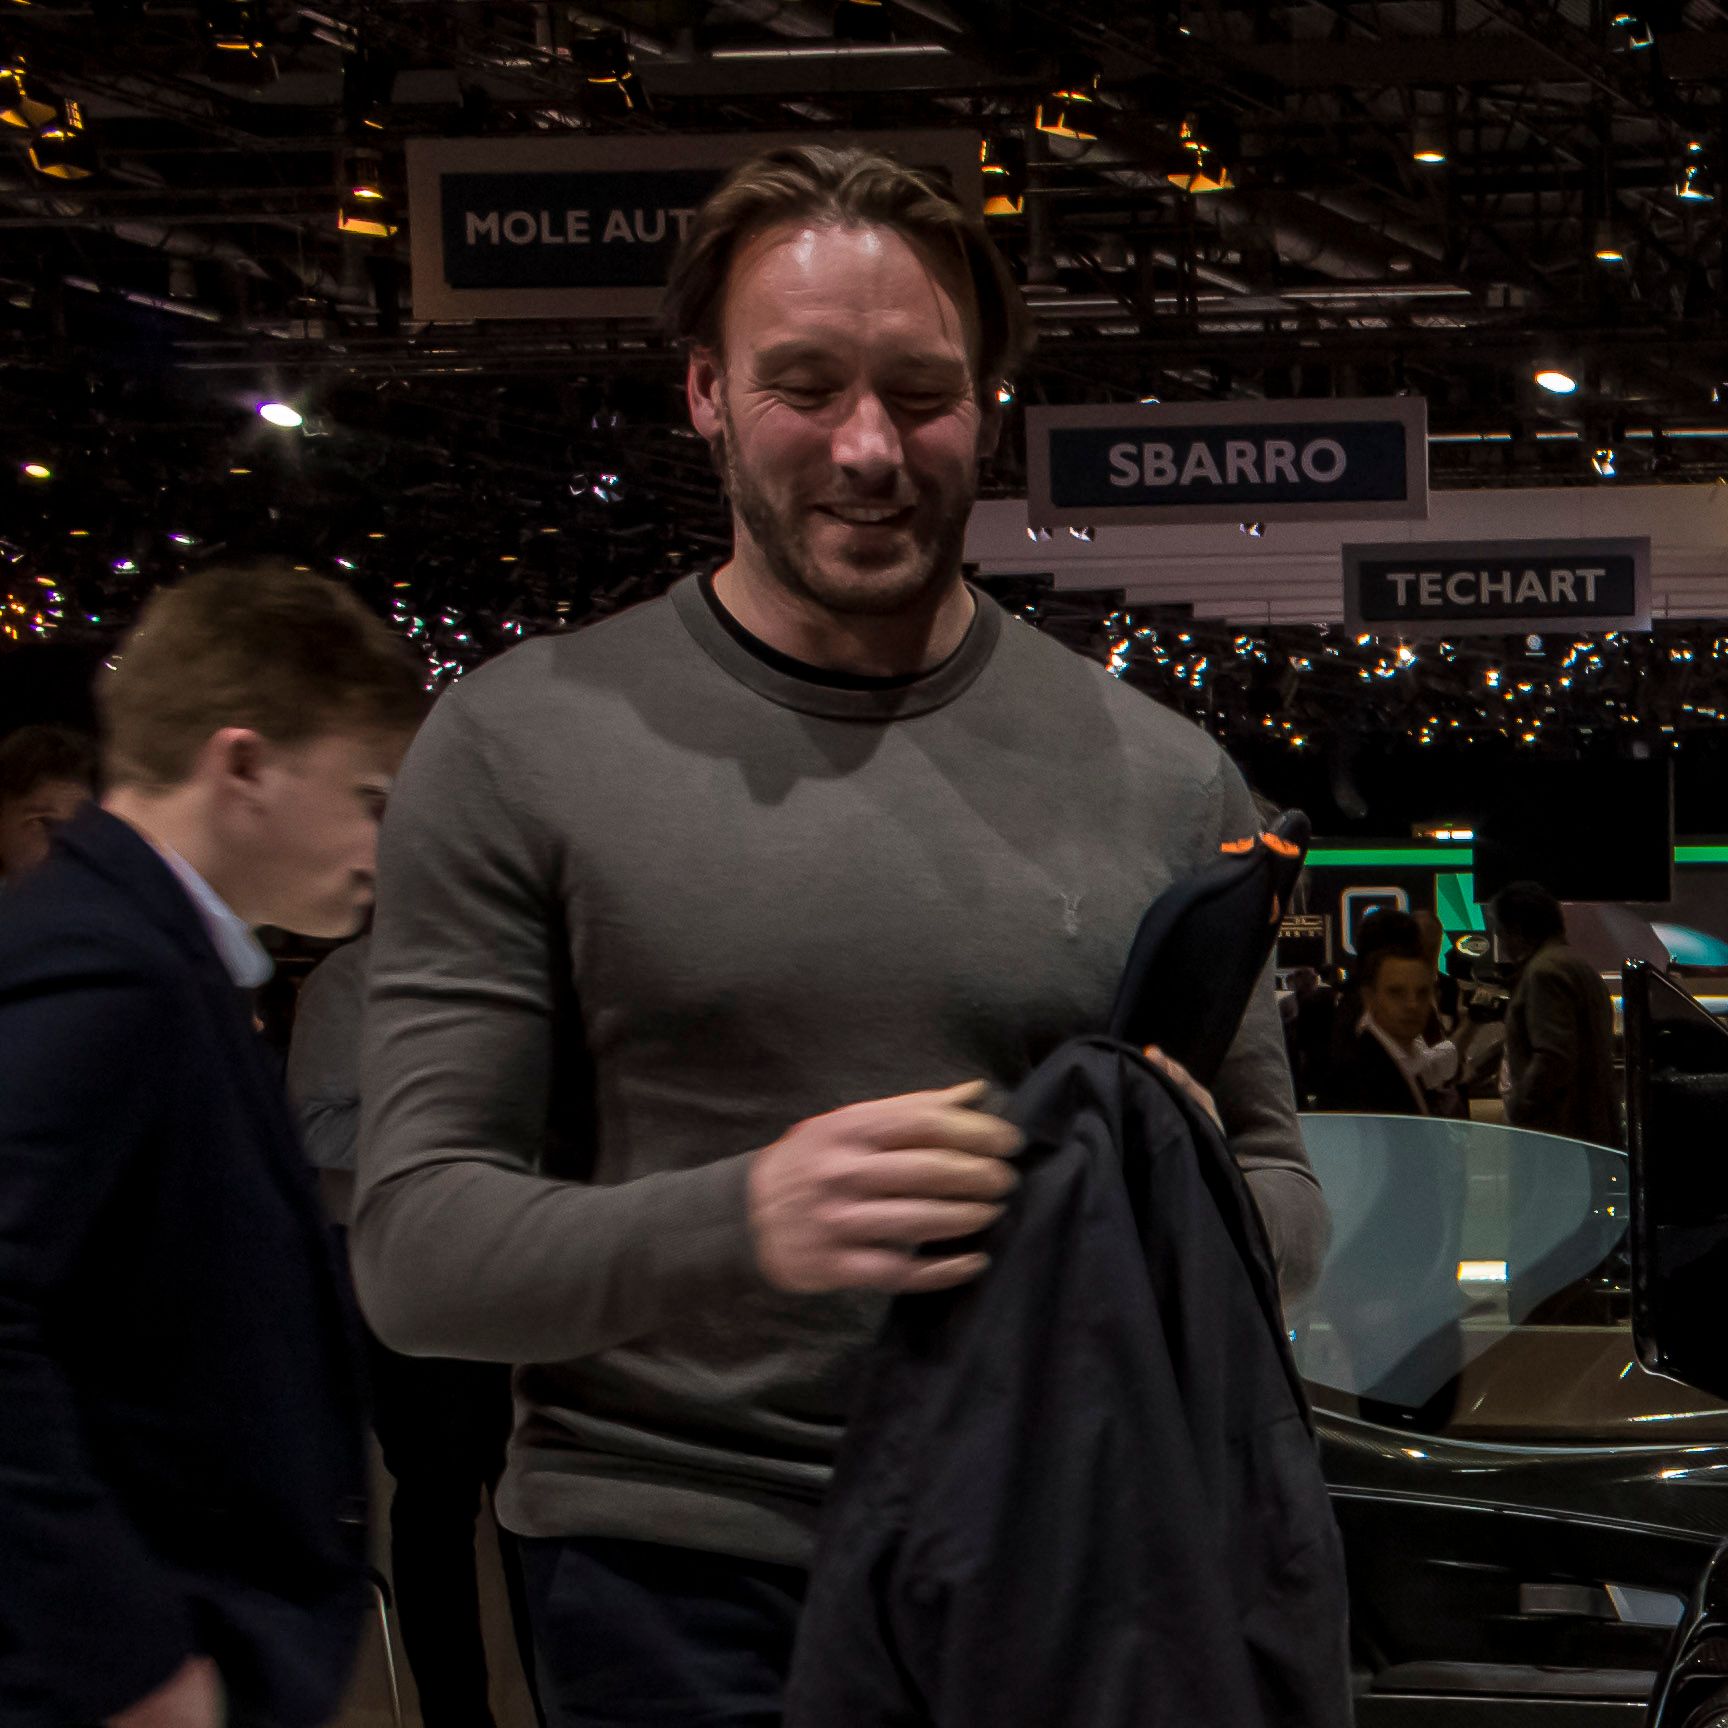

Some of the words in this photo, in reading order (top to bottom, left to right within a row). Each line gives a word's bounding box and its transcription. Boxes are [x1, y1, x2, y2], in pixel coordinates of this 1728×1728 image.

[464, 208, 591, 246] MOLE
[1107, 437, 1348, 488] SBARRO
[1387, 568, 1606, 608] TECHART
